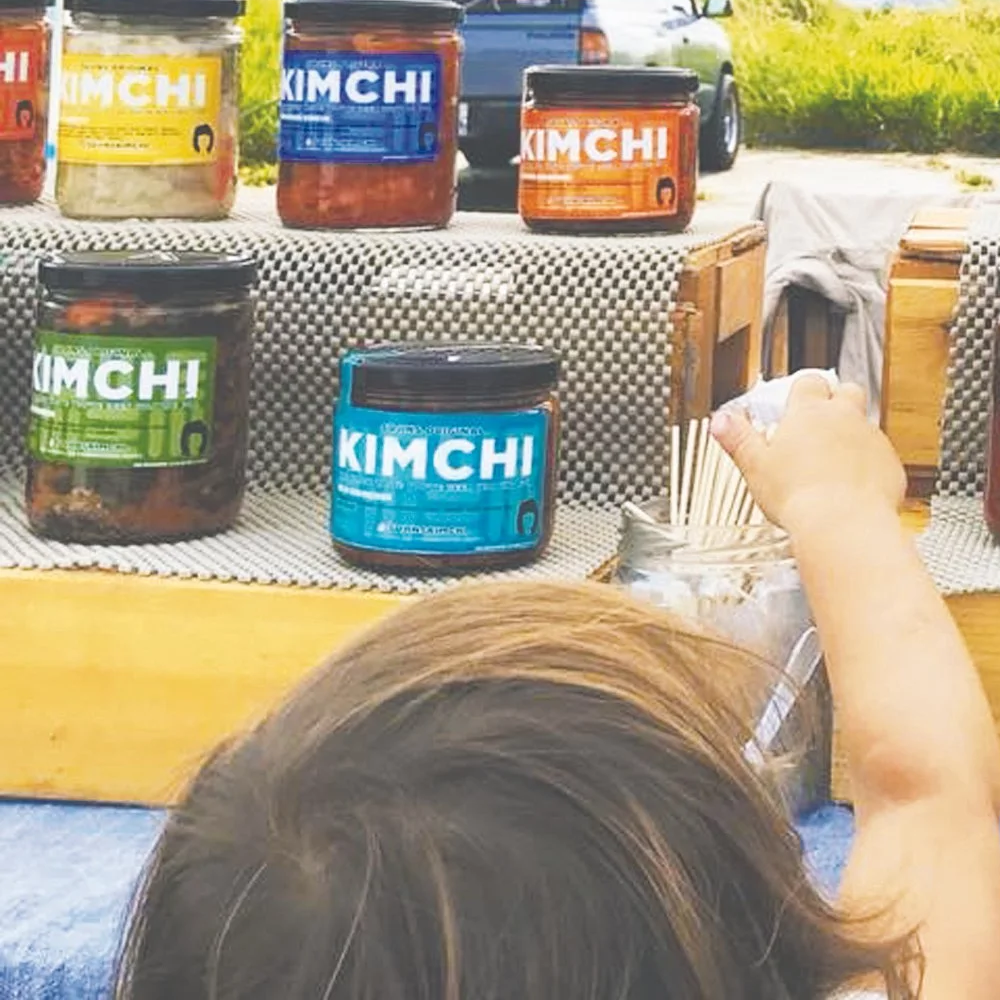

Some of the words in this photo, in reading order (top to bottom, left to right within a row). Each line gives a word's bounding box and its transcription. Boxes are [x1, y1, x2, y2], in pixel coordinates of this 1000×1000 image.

[282, 68, 432, 103] KIMCHI
[521, 127, 668, 162] KIMCHI
[338, 428, 534, 480] KIMCHI
